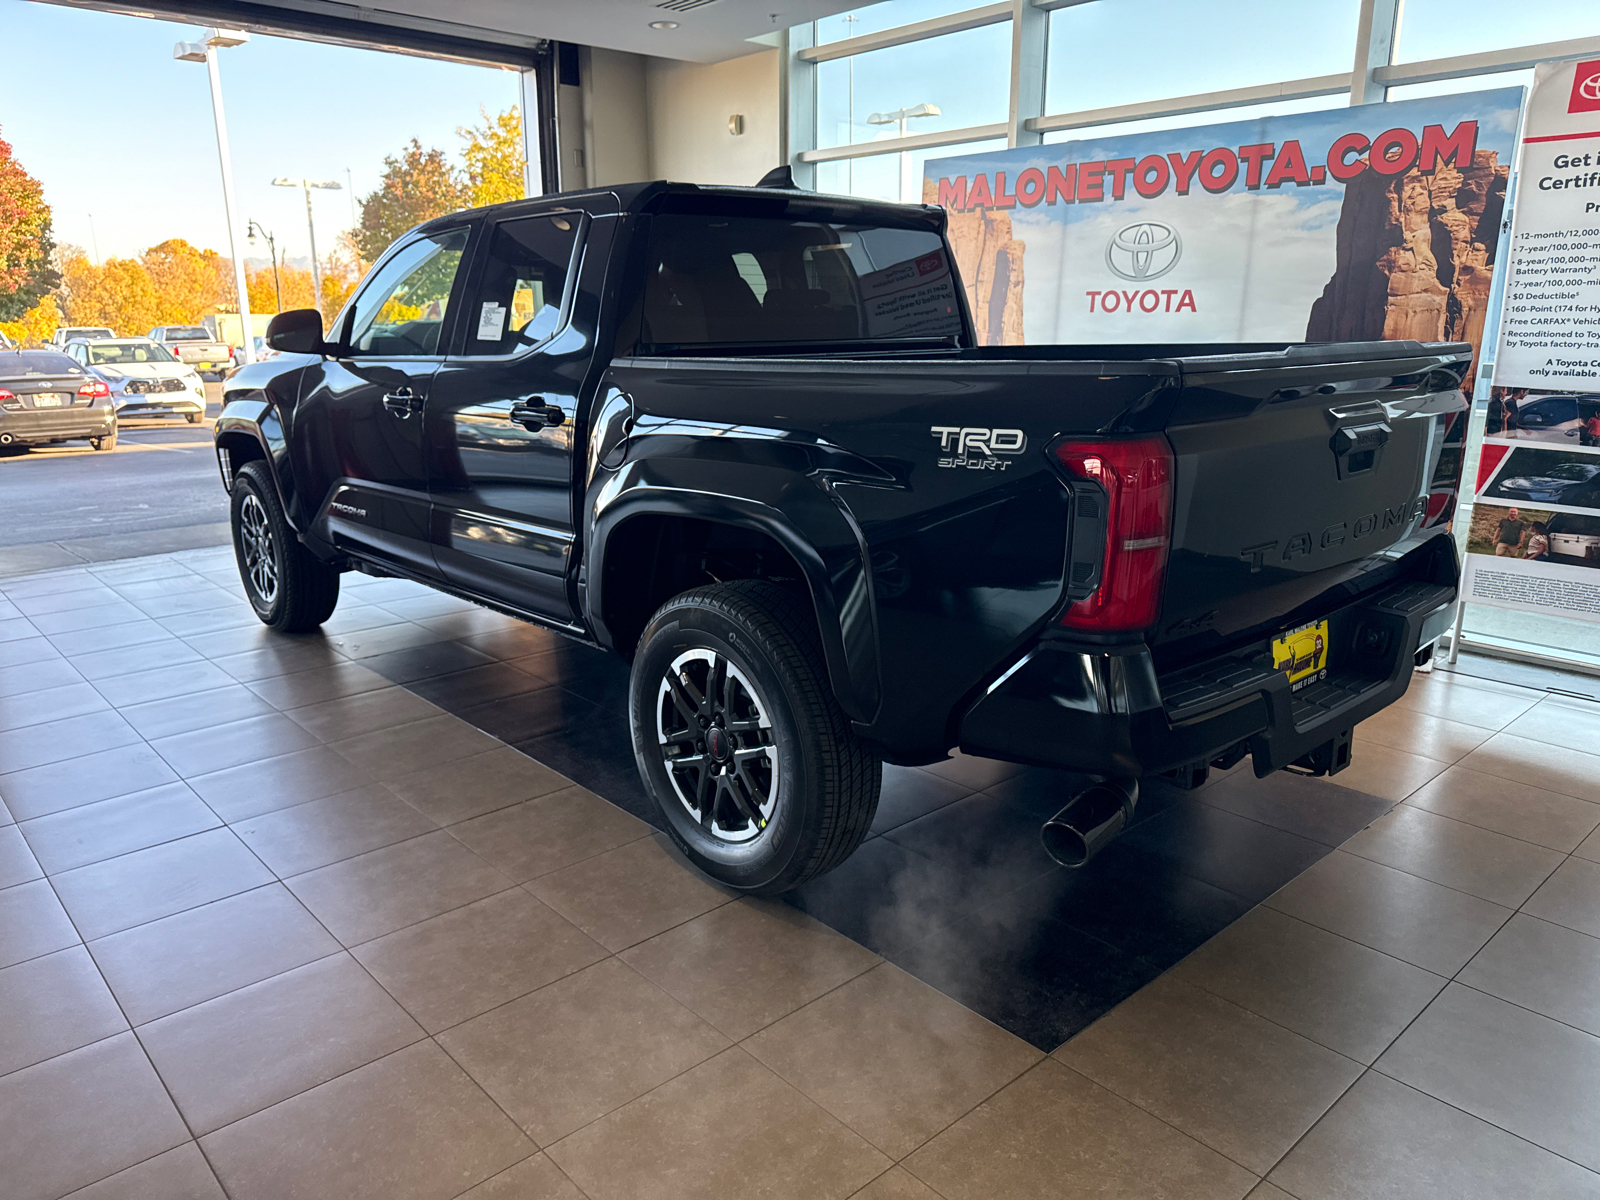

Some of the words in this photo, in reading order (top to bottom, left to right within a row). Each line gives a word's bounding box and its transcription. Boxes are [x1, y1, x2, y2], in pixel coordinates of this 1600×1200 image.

[938, 120, 1479, 213] MALONETOYOTA.COM
[1554, 153, 1592, 169] Get
[1085, 289, 1197, 314] TOYOTA
[1554, 305, 1573, 313] (174
[1506, 340, 1518, 348] by
[1519, 340, 1548, 348] Toyota
[1556, 359, 1588, 368] Toyota
[1529, 368, 1550, 377] only
[1552, 369, 1598, 377] available
[930, 426, 1027, 459] TRD
[937, 457, 1012, 471] SPORT
[1240, 496, 1428, 573] TACOMA
